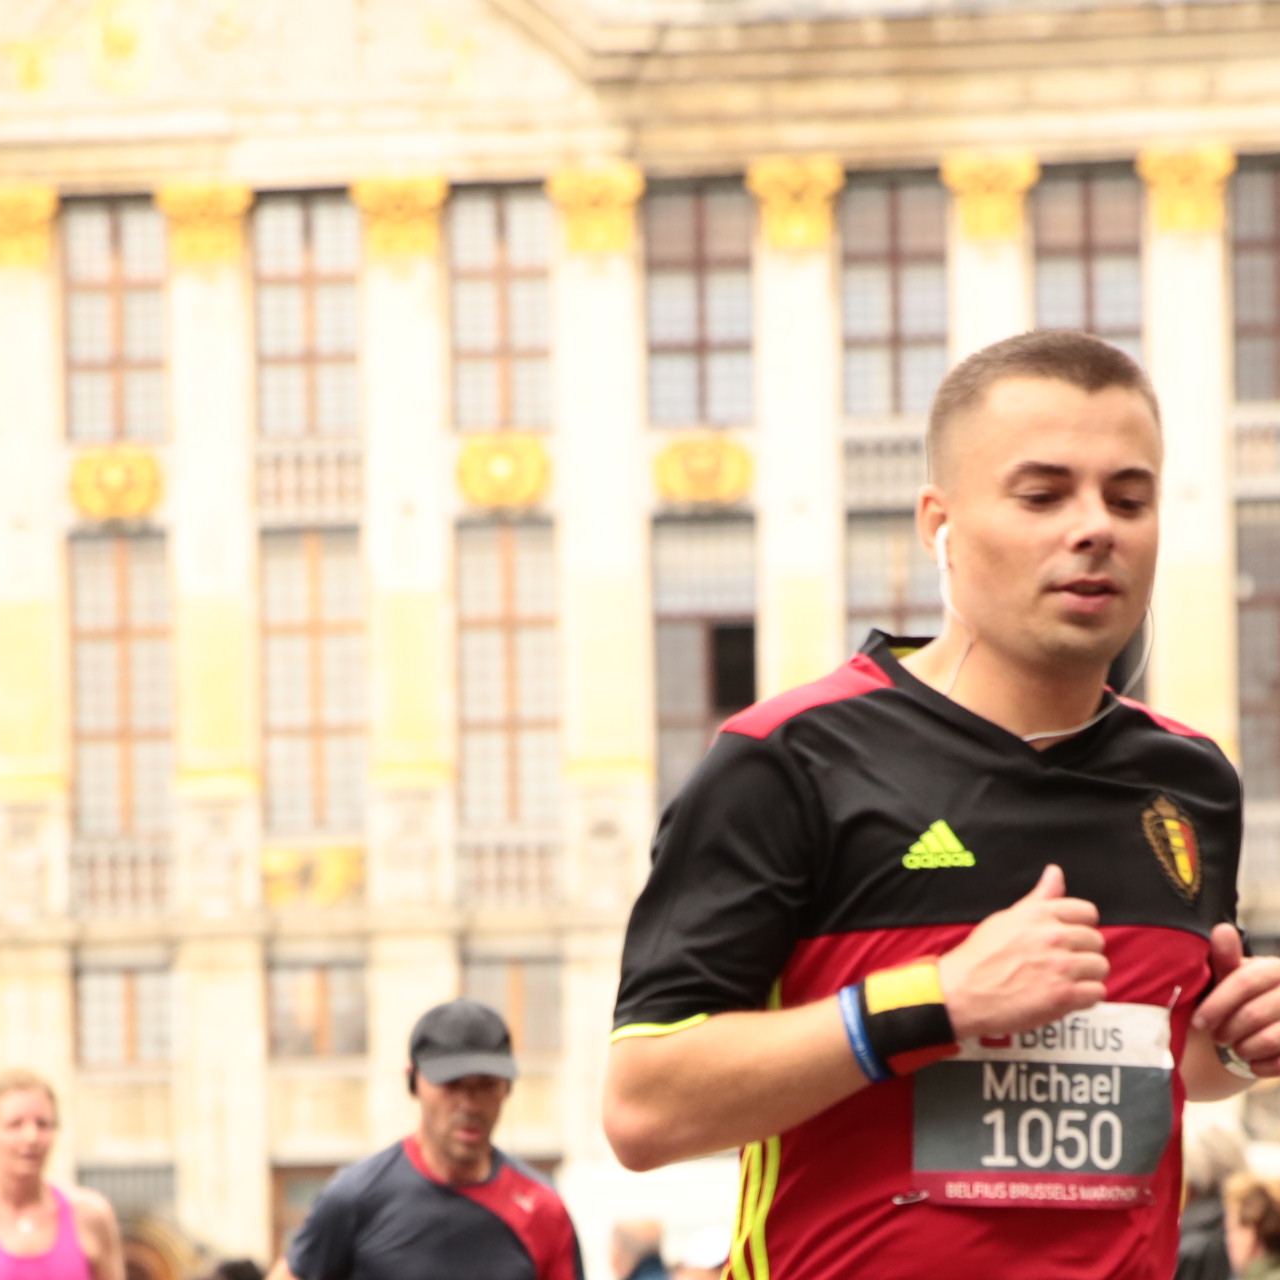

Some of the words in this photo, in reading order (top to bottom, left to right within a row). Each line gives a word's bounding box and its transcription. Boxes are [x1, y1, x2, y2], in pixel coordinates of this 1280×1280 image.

[982, 1062, 1121, 1105] Michael
[980, 1107, 1123, 1171] 1050
[945, 1181, 1007, 1199] BELFIUS
[1009, 1182, 1078, 1200] BRUSSELS
